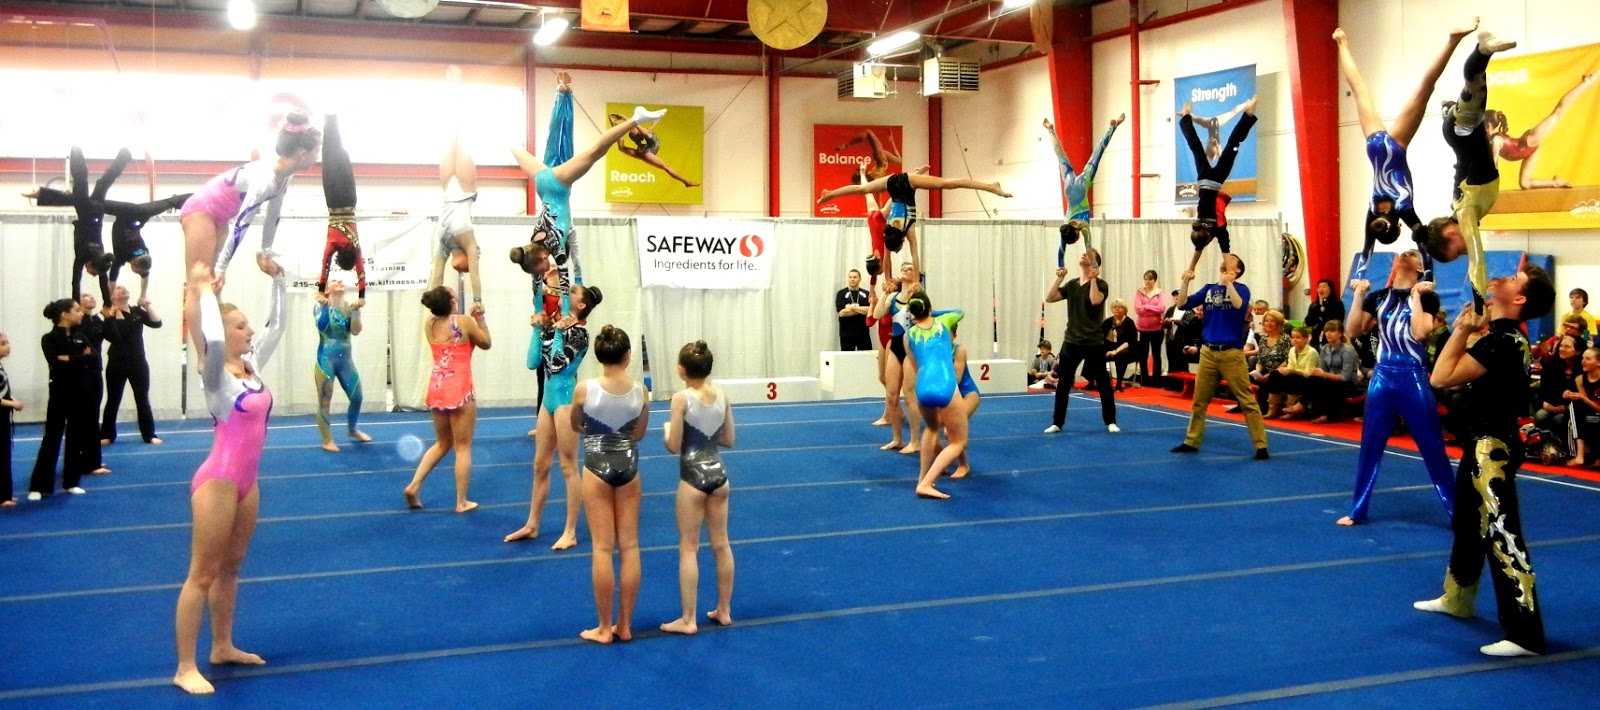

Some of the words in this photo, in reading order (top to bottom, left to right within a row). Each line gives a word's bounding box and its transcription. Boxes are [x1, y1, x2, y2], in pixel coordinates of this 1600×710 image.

[1486, 68, 1529, 88] ocus
[1191, 82, 1237, 102] Strength
[819, 152, 872, 165] Balance
[609, 169, 656, 183] Reach
[646, 234, 738, 254] SAFEWAY
[653, 258, 716, 271] Ingredients
[718, 259, 735, 270] for
[980, 363, 990, 381] 2
[766, 381, 778, 401] 3
